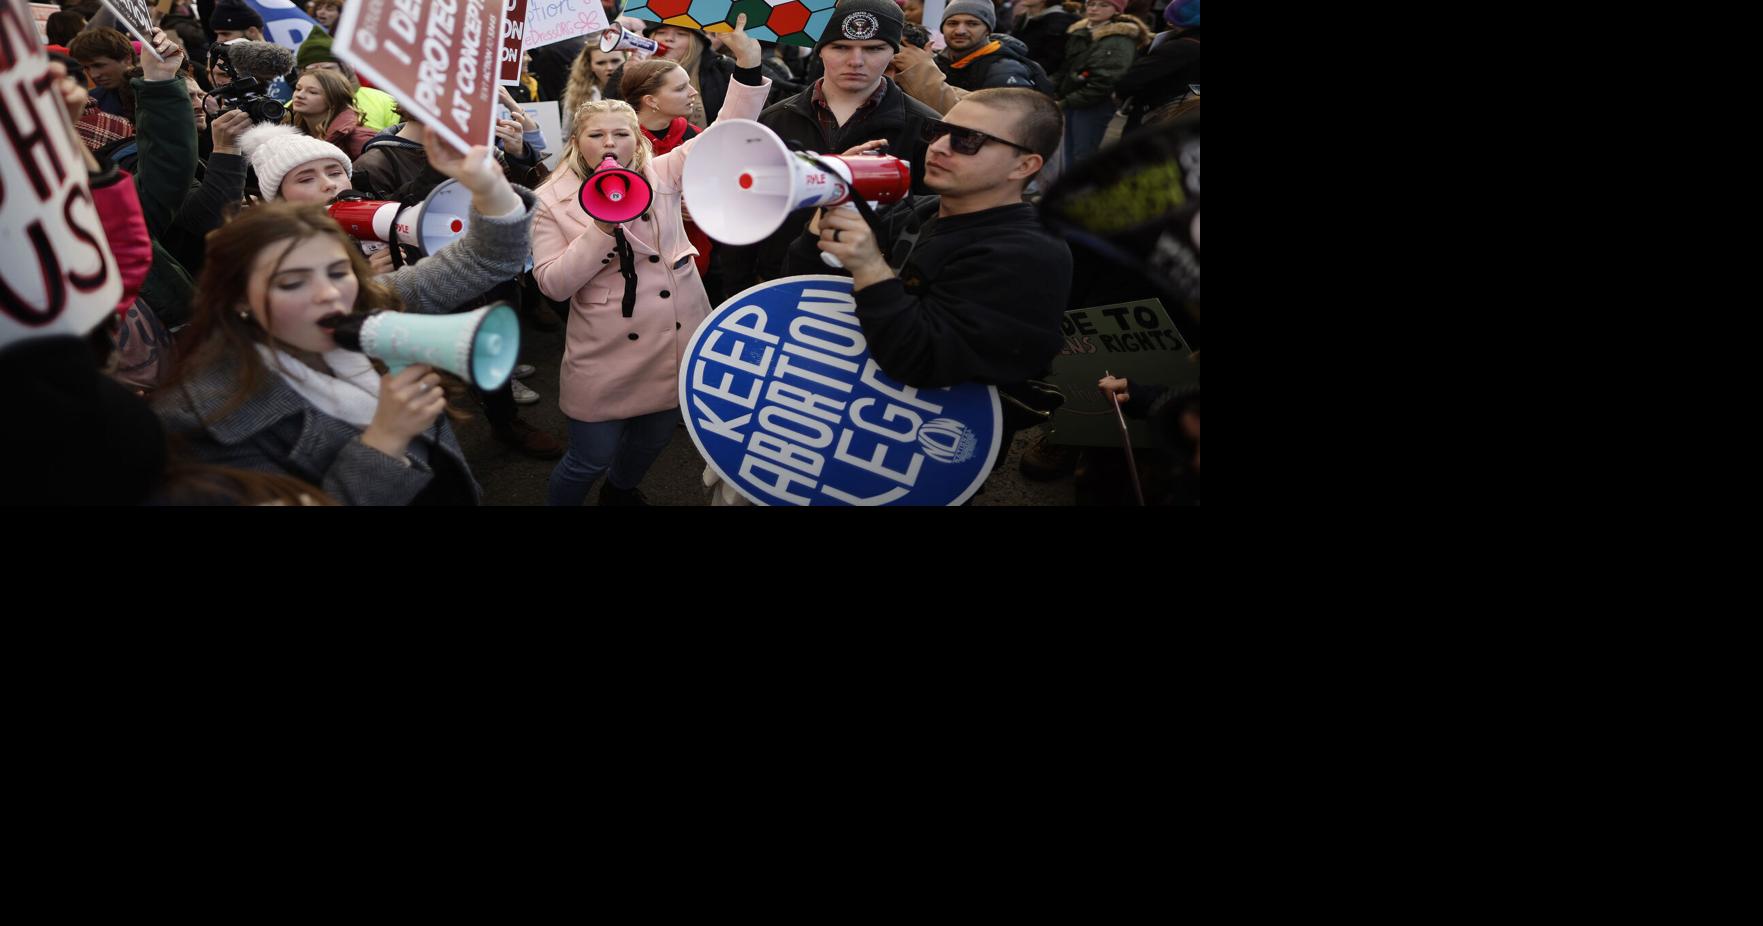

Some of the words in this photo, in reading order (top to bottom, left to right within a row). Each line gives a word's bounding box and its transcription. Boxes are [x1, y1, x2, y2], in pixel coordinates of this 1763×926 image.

[384, 40, 412, 66] I
[451, 90, 472, 134] AT
[1102, 306, 1159, 331] TO
[1099, 329, 1183, 353] RIGHTS
[692, 304, 780, 443] KEEP
[738, 288, 867, 505] ABORTION
[821, 358, 944, 506] LEGA
